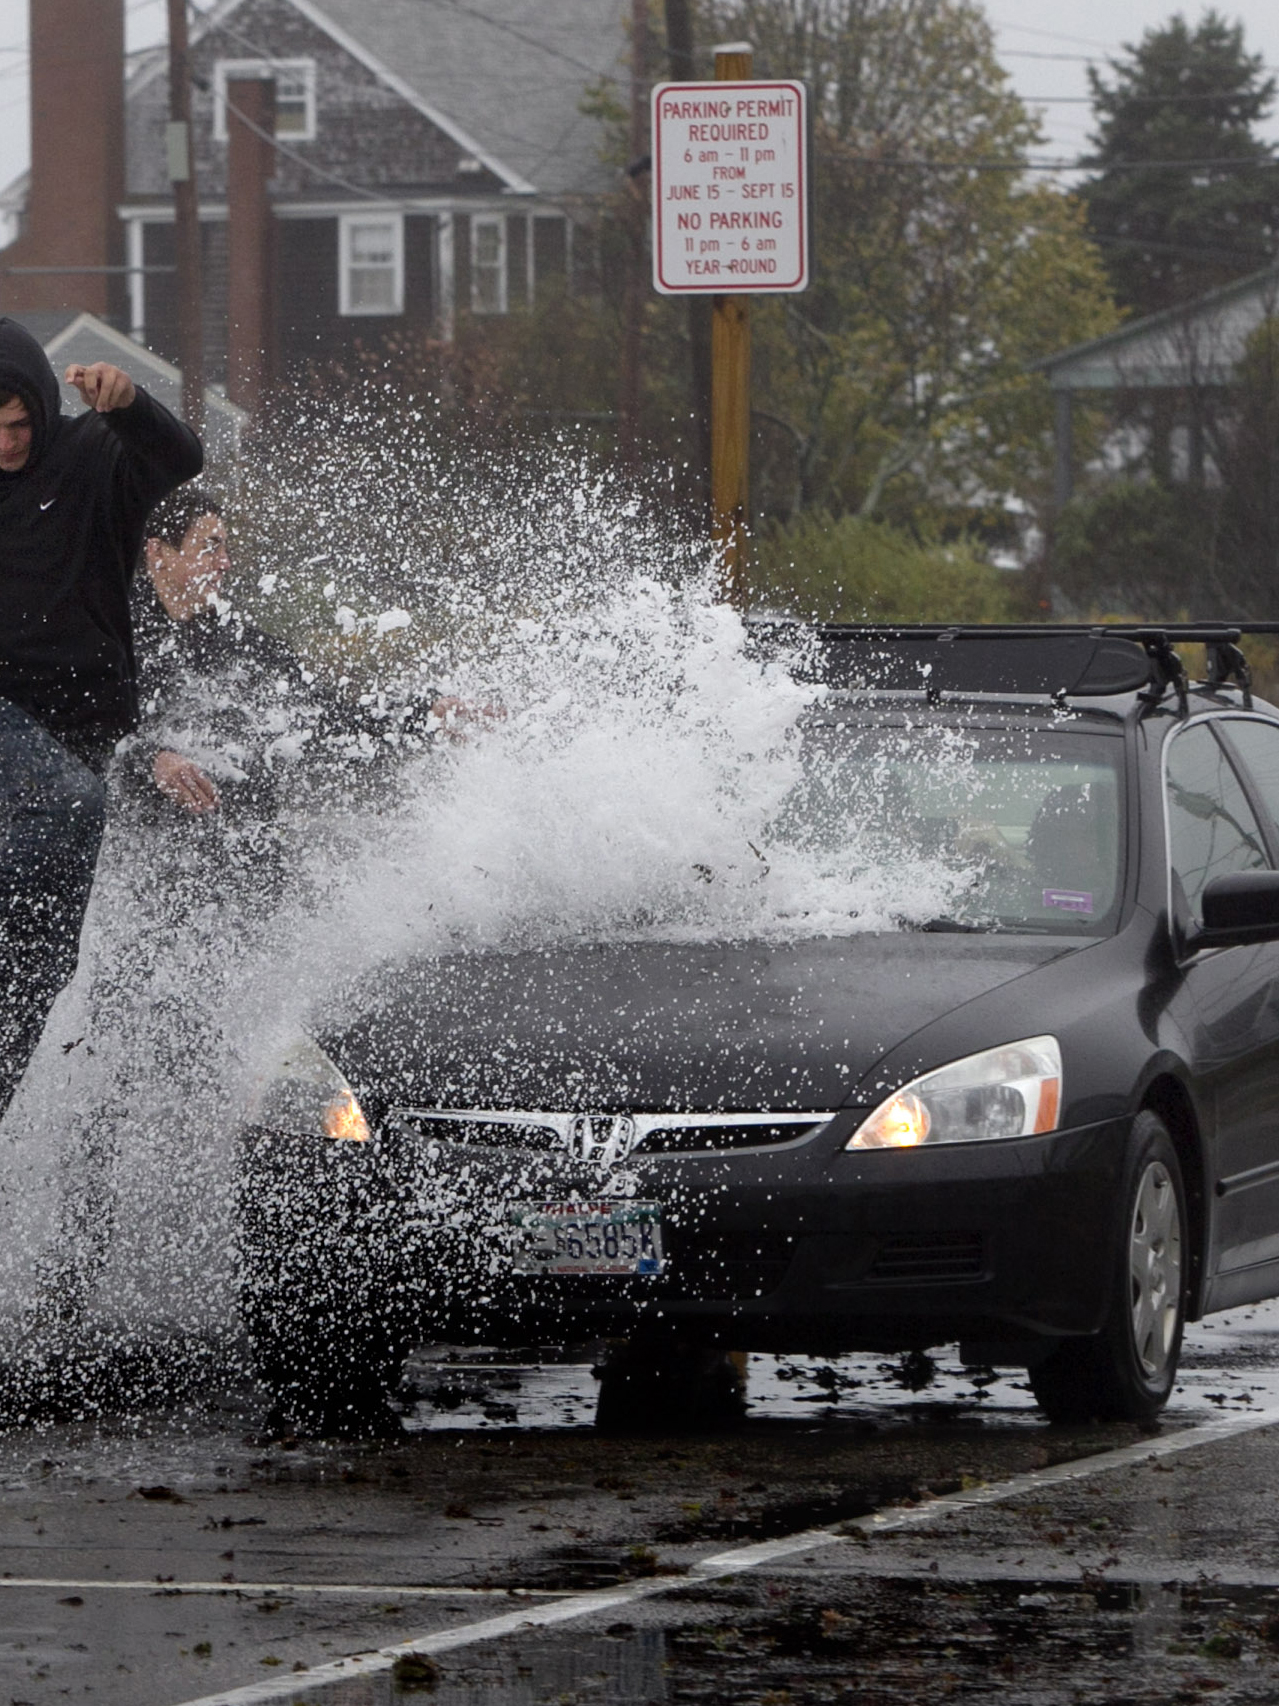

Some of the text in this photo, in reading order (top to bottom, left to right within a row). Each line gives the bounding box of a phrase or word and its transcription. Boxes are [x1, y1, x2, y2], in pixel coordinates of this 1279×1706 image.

[663, 98, 793, 119] PARKING PERMIT
[688, 122, 769, 142] REQUIRED
[684, 148, 693, 163] 6
[698, 150, 719, 163] am
[740, 146, 749, 161] 11
[755, 149, 775, 164] pm
[713, 166, 746, 180] FROM
[667, 185, 700, 201] JUNE
[707, 184, 720, 199] 15
[742, 183, 774, 199] SEPT
[781, 182, 794, 199] 15
[677, 210, 782, 230] NO PARKING
[685, 237, 694, 252] 11
[700, 239, 719, 254] pm
[741, 236, 749, 251] 6
[756, 237, 776, 251] am
